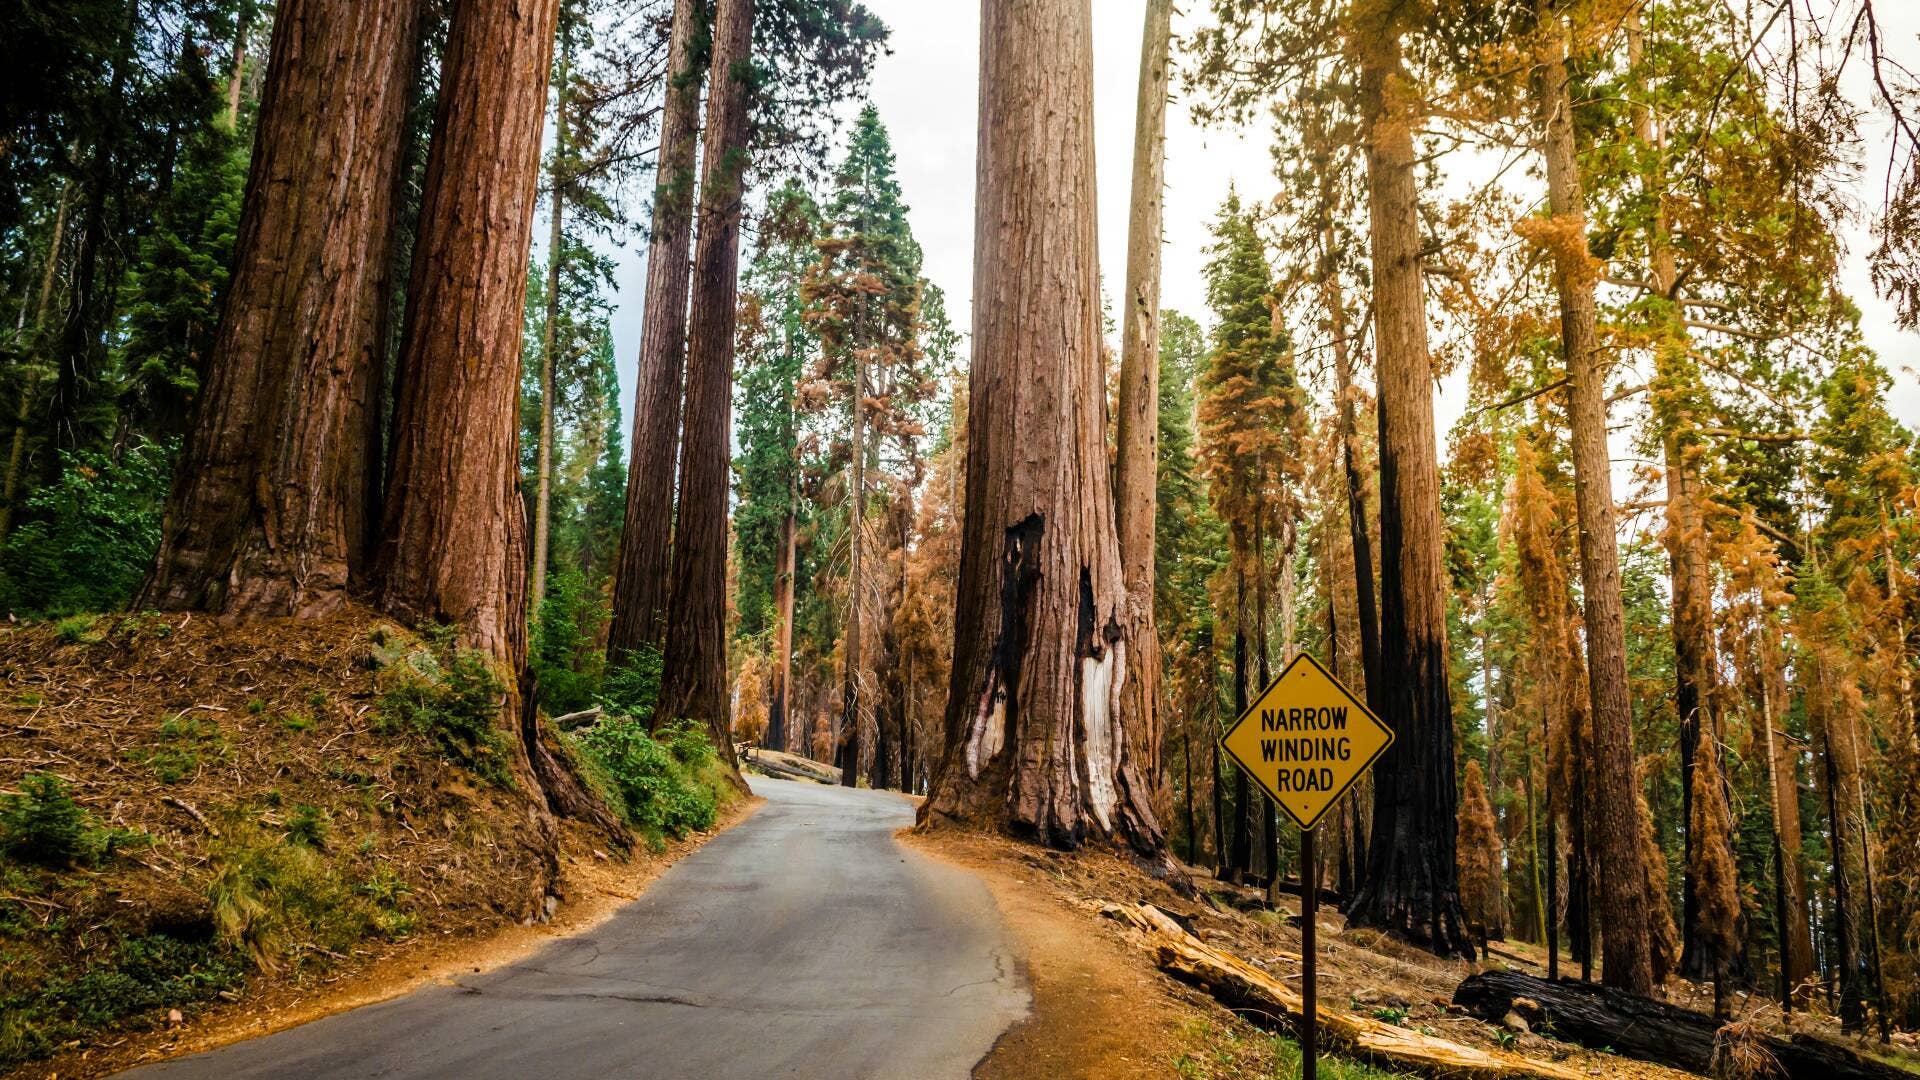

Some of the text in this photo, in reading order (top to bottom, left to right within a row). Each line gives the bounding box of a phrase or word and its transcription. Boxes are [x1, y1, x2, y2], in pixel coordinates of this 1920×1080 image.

[1261, 707, 1348, 732] NARROW
[1261, 737, 1351, 762] WINDING
[1277, 768, 1334, 792] ROAD
